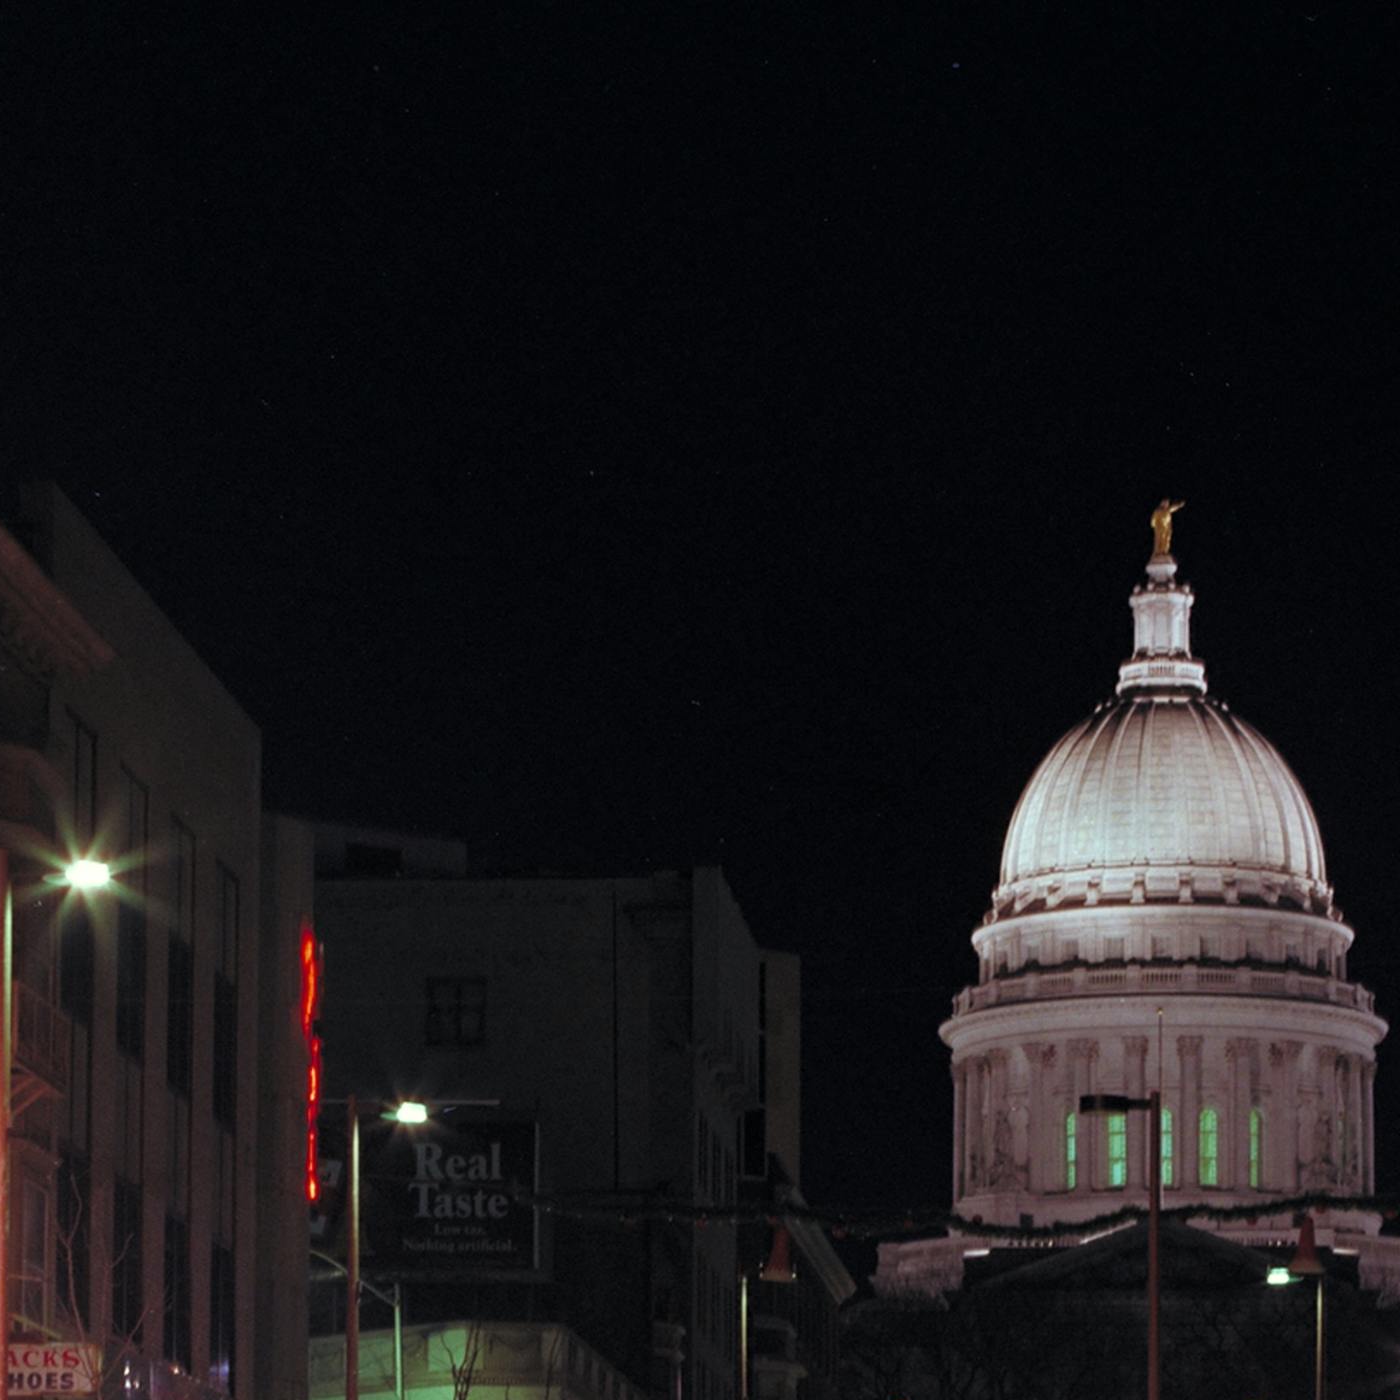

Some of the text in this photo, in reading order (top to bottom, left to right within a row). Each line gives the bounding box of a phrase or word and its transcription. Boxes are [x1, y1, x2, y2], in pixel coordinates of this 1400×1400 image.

[412, 1142, 504, 1181] Real
[408, 1183, 509, 1219] Taste
[8, 1371, 75, 1390] HOES
